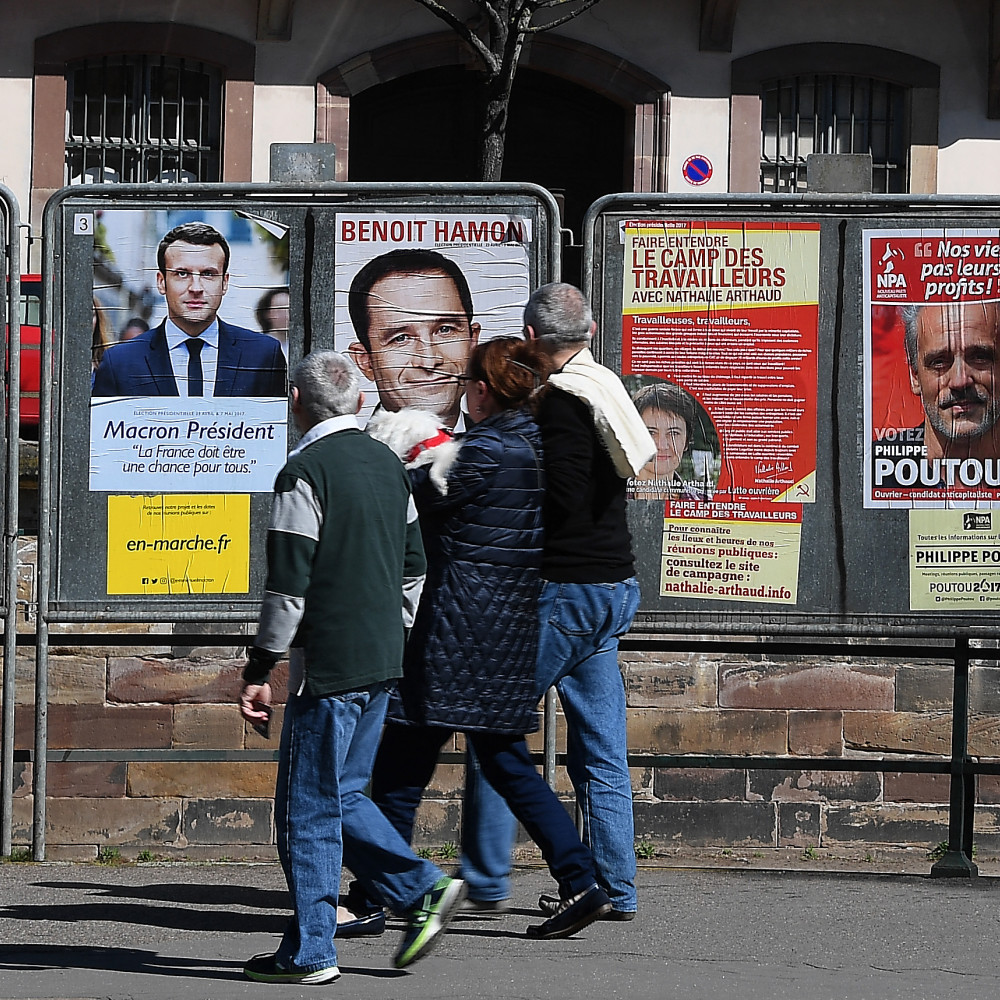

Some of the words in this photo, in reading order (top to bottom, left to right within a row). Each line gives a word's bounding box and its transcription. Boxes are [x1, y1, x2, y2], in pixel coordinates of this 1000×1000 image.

[79, 218, 88, 231] 3
[341, 220, 428, 242] BENOIT
[434, 220, 524, 243] HAMON
[632, 236, 665, 248] FAIRE
[668, 236, 729, 248] ENTENDRE
[937, 240, 971, 258] Nos
[632, 249, 656, 269] LE
[660, 248, 720, 268] CAMP
[725, 247, 764, 267] DES
[631, 267, 787, 289] TRAVAILLEURS
[920, 262, 953, 282] pas
[876, 273, 907, 288] NPA
[631, 290, 663, 303] AVEC
[666, 290, 723, 303] NATHALIE
[725, 289, 782, 302] ARTHAUD
[632, 315, 695, 325] Travailleuses,
[696, 316, 751, 326] travailleurs,
[103, 421, 179, 439] Macron
[187, 421, 275, 440] Président
[874, 427, 925, 442] VOTEZ
[156, 445, 195, 458] France
[198, 445, 220, 458] doit
[223, 445, 245, 458] être
[875, 445, 928, 456] PHILIPPE
[122, 463, 145, 473] une
[148, 460, 190, 473] chance
[193, 462, 221, 477] pour
[874, 490, 902, 498] Ouvrier
[909, 490, 940, 498] candidat
[670, 501, 696, 509] FAIRE
[698, 502, 746, 511] ENTENDRE
[670, 509, 681, 517] LE
[683, 509, 710, 518] CAMP
[712, 510, 730, 518] DES
[731, 511, 797, 520] TRAVAILLEURS
[975, 516, 990, 524] NPA
[668, 524, 689, 532] Pour
[690, 526, 731, 535] connaître
[126, 534, 232, 554] en-marche.fr
[667, 533, 680, 542] les
[682, 534, 704, 543] lieux
[705, 536, 714, 544] et
[716, 536, 745, 546] heures
[746, 538, 757, 546] de
[759, 540, 775, 548] nos
[667, 544, 716, 556] réunions
[916, 550, 978, 563] PHILIPPE
[666, 558, 722, 570] consultez
[725, 559, 736, 570] le
[738, 561, 760, 572] site
[666, 567, 680, 577] de
[682, 570, 744, 582] campagne
[665, 580, 791, 600] nathalie-arthaud.info
